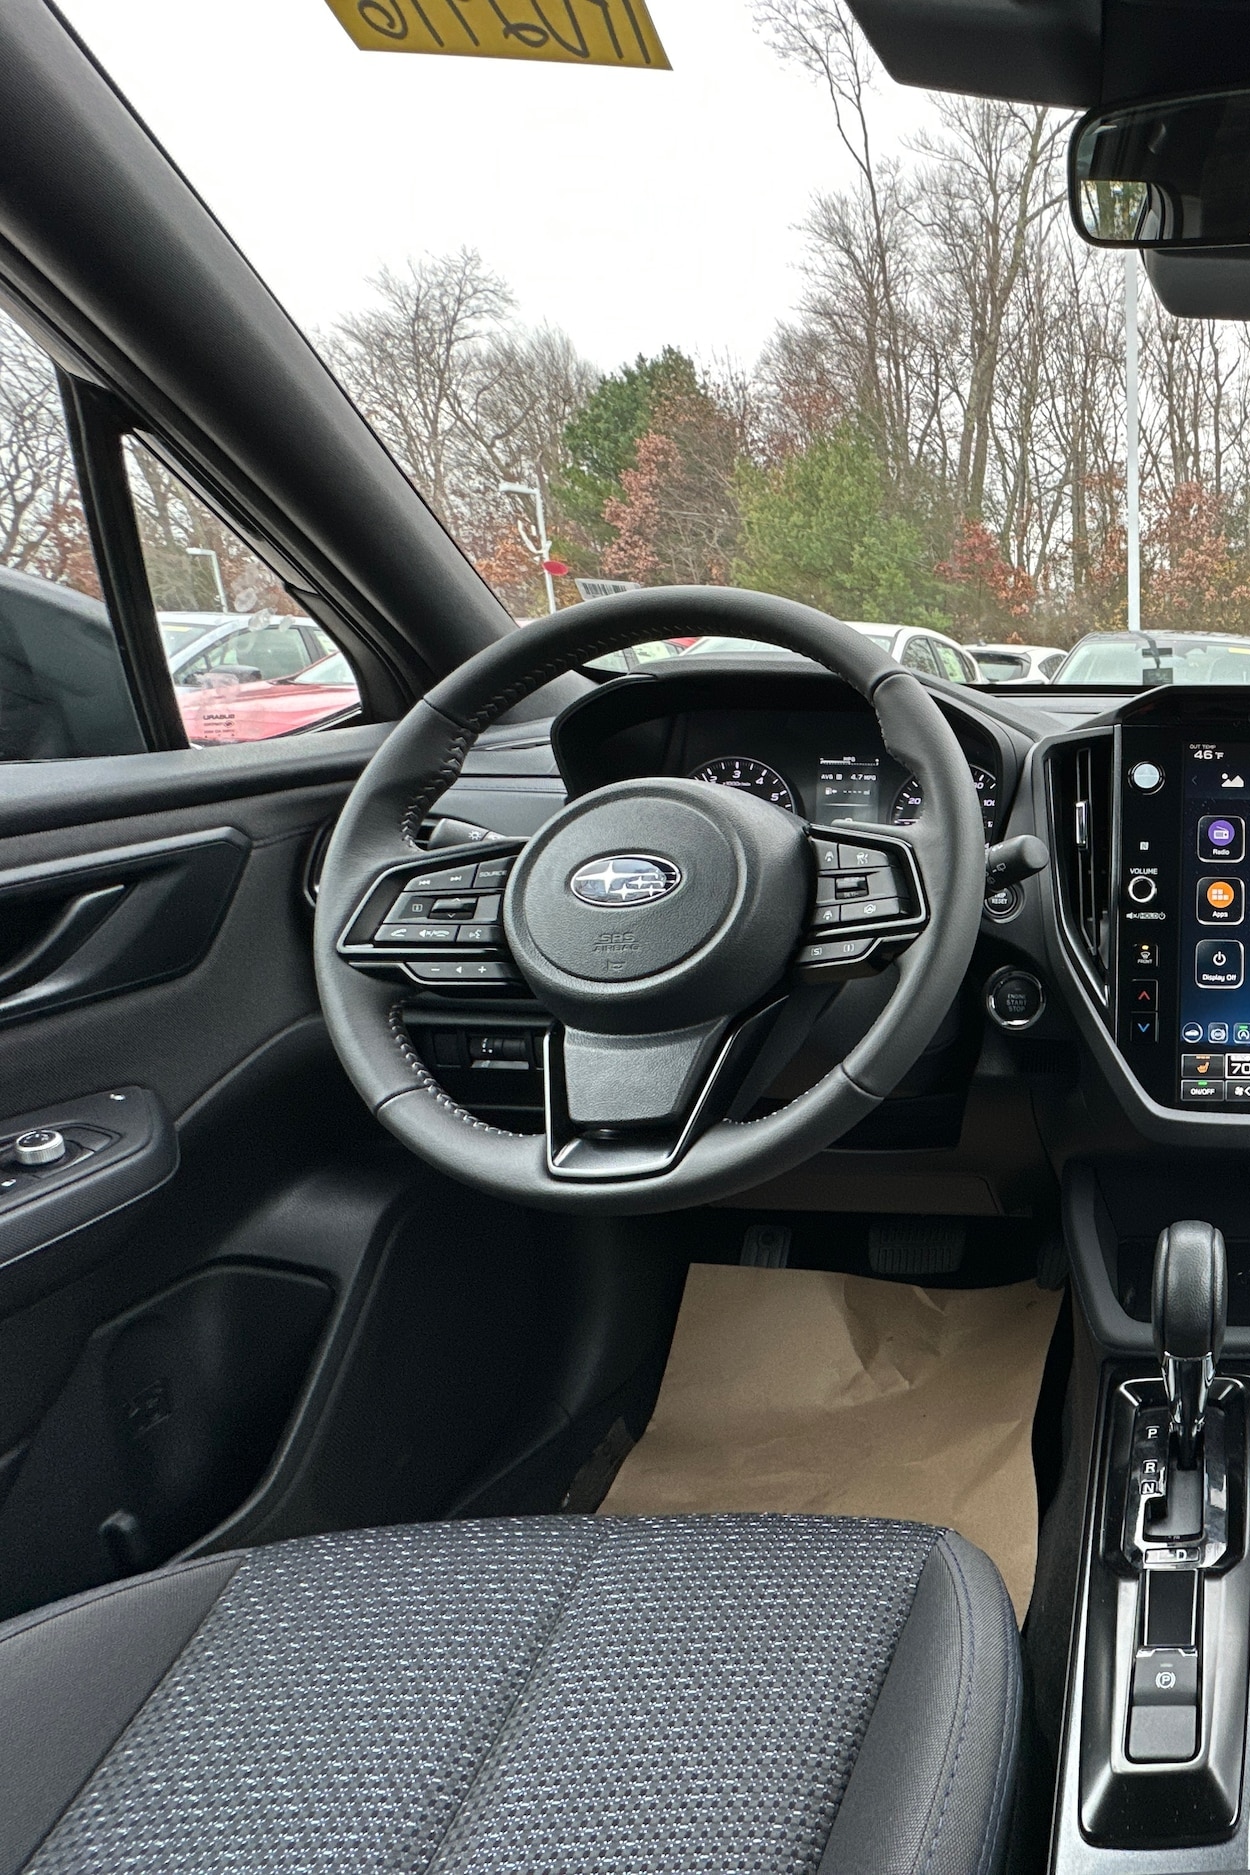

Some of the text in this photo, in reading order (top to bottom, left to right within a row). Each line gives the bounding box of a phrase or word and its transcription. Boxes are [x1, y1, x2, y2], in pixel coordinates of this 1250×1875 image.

[1194, 750, 1213, 760] 46
[732, 770, 741, 778] 3
[755, 777, 764, 785] 4
[770, 793, 779, 801] 5
[1213, 848, 1230, 856] Radio
[479, 870, 507, 878] SOURCE
[600, 932, 636, 942] SRS
[1202, 974, 1226, 982] Display
[1190, 1088, 1216, 1096] ON/OFF
[1148, 1428, 1158, 1438] P
[1146, 1462, 1156, 1472] R
[1144, 1482, 1154, 1493] N
[1176, 1549, 1187, 1560] D
